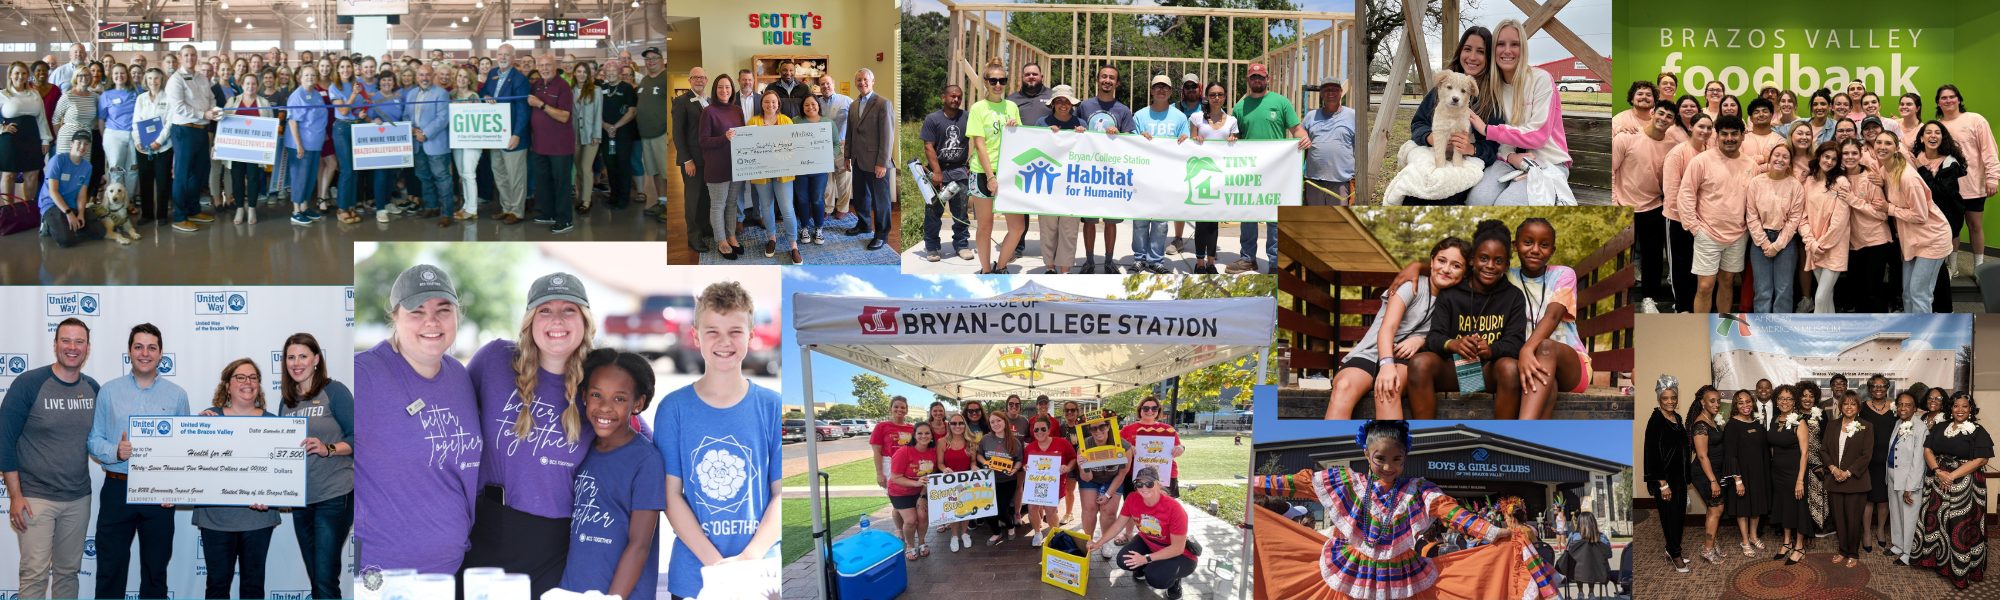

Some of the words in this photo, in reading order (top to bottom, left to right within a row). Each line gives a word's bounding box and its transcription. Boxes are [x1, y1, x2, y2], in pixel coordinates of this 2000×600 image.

[749, 12, 822, 29] SCOTTY'S
[763, 31, 812, 46] HOUSE
[1660, 28, 1786, 48] BRAZOS
[1805, 28, 1922, 48] VALLEY
[1661, 52, 1921, 98] foodbank
[453, 114, 502, 132] GIVES
[1068, 152, 1121, 164] Bryan/College
[1124, 154, 1150, 165] Station
[1223, 156, 1258, 168] TINY
[1067, 164, 1133, 186] Habitat
[1224, 174, 1262, 186] HOPE
[1066, 185, 1081, 196] for
[1084, 186, 1132, 201] Humanity
[1224, 193, 1281, 206] VILLAGE
[49, 295, 76, 304] United
[197, 294, 224, 302] United
[60, 305, 76, 313] Way
[208, 303, 224, 313] Way
[902, 312, 1111, 334] BRYAN-COLLEGE
[1118, 314, 1217, 337] STATION
[1459, 314, 1504, 332] RAYBURN
[45, 398, 65, 409] LIVE
[67, 399, 93, 410] UNITED
[503, 388, 559, 422] beter
[419, 404, 458, 438] better
[141, 428, 154, 437] Way
[187, 449, 208, 457] Health
[424, 426, 483, 469] together
[1428, 461, 1456, 470] BOYS
[1468, 463, 1498, 472] GIRLS
[1500, 464, 1530, 473] CLUBS
[929, 470, 992, 485] TODAY
